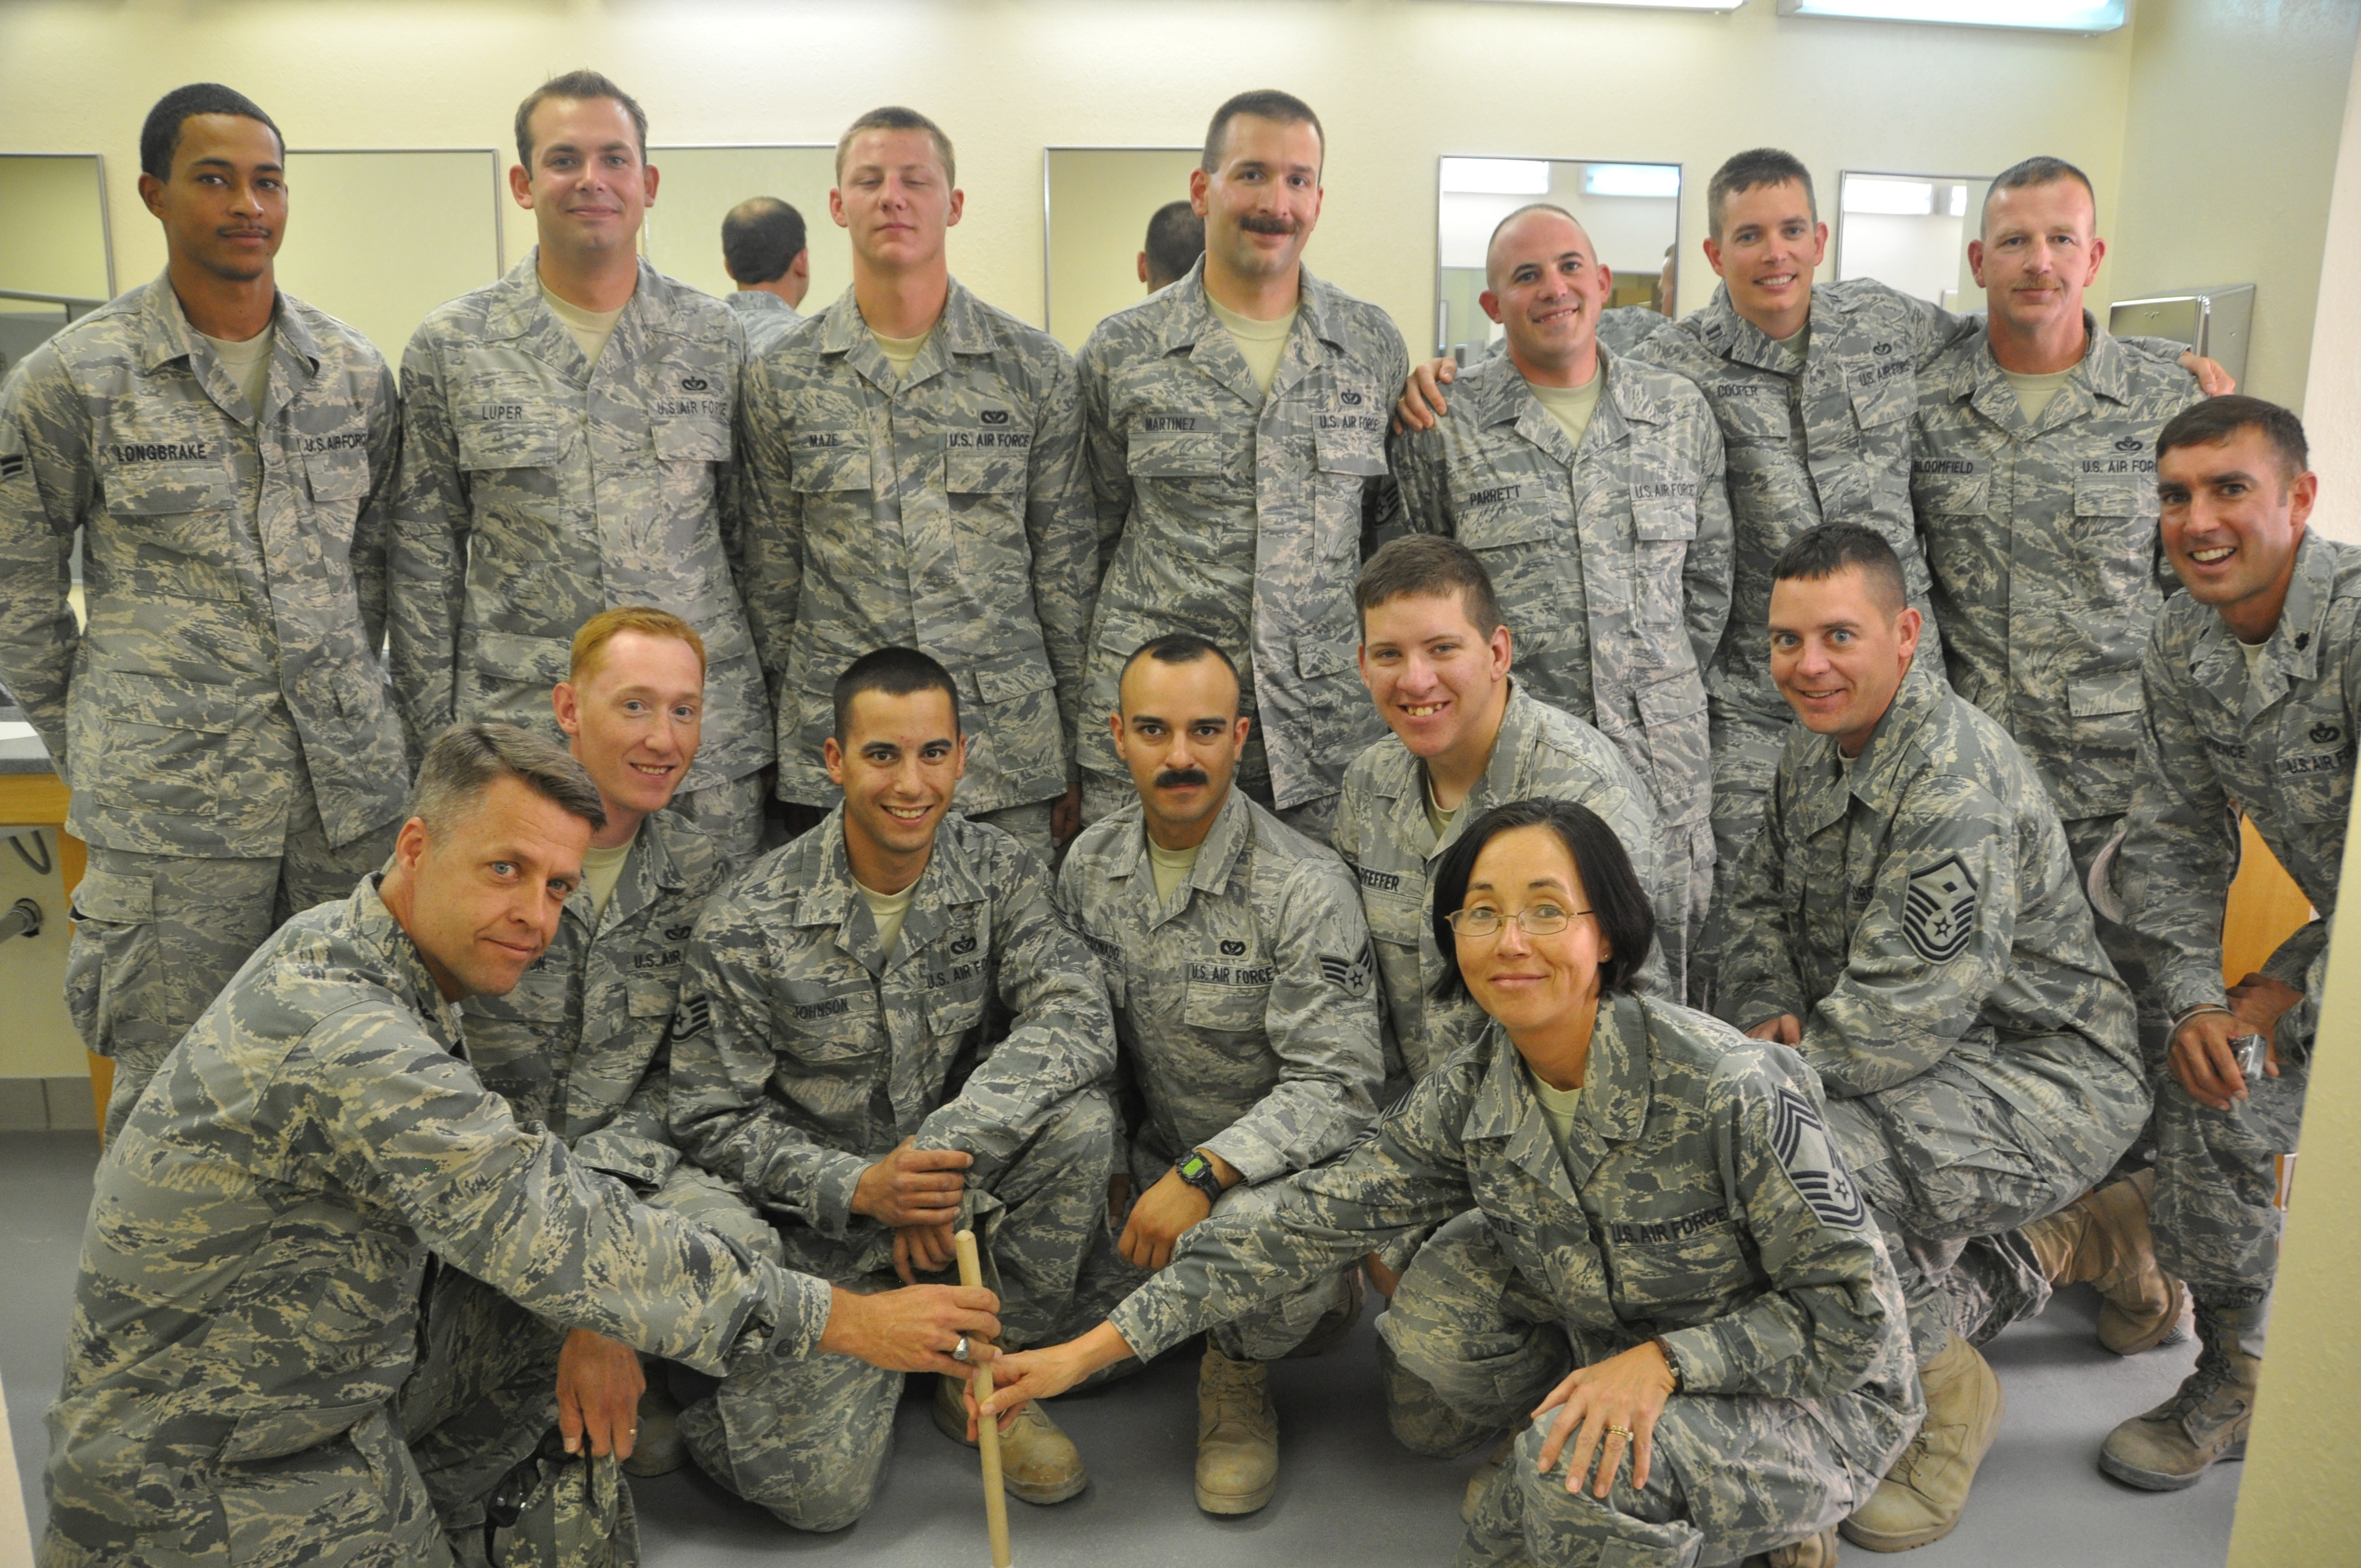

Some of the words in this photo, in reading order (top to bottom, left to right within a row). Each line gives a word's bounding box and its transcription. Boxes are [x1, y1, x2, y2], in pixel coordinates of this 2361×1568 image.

[1876, 365, 1892, 382] AIR
[1717, 384, 1758, 398] COOPER
[482, 405, 523, 420] LUPER
[679, 401, 698, 415] AIR
[701, 400, 727, 416] FOE
[1145, 417, 1196, 432] MARTINEZ
[1319, 415, 1340, 429] U.S.
[1342, 415, 1357, 428] AIR
[1359, 416, 1380, 432] FORCE
[341, 433, 368, 449] FOR
[809, 433, 838, 448] MAZE
[949, 433, 975, 447] U.S.
[977, 433, 995, 447] AIR
[997, 433, 1030, 448] FORCE
[116, 444, 208, 462] LONGBRAKE
[1913, 460, 1973, 474] BLOOMFIELD
[2082, 460, 2103, 473] U.S.
[2108, 460, 2128, 473] AIR
[2132, 460, 2158, 473] FOR
[1470, 484, 1521, 506] PARRETT
[1635, 484, 1653, 498] U.S.
[1655, 483, 1669, 497] AIR
[1671, 483, 1695, 497] FORE
[2312, 755, 2338, 771] AR
[1361, 868, 1400, 892] PFEFFER
[634, 954, 660, 968] U.S.
[660, 949, 682, 966] AIR
[926, 972, 949, 989] U.S.
[952, 964, 971, 982] AIR
[1190, 964, 1209, 980] U.S.
[1211, 966, 1231, 984] AIR
[1235, 967, 1274, 984] FORCE
[791, 997, 848, 1019] JOHNSON
[1611, 1223, 1637, 1244] U.S.
[1639, 1223, 1668, 1244] AIR
[1671, 1206, 1729, 1239] FORCE
